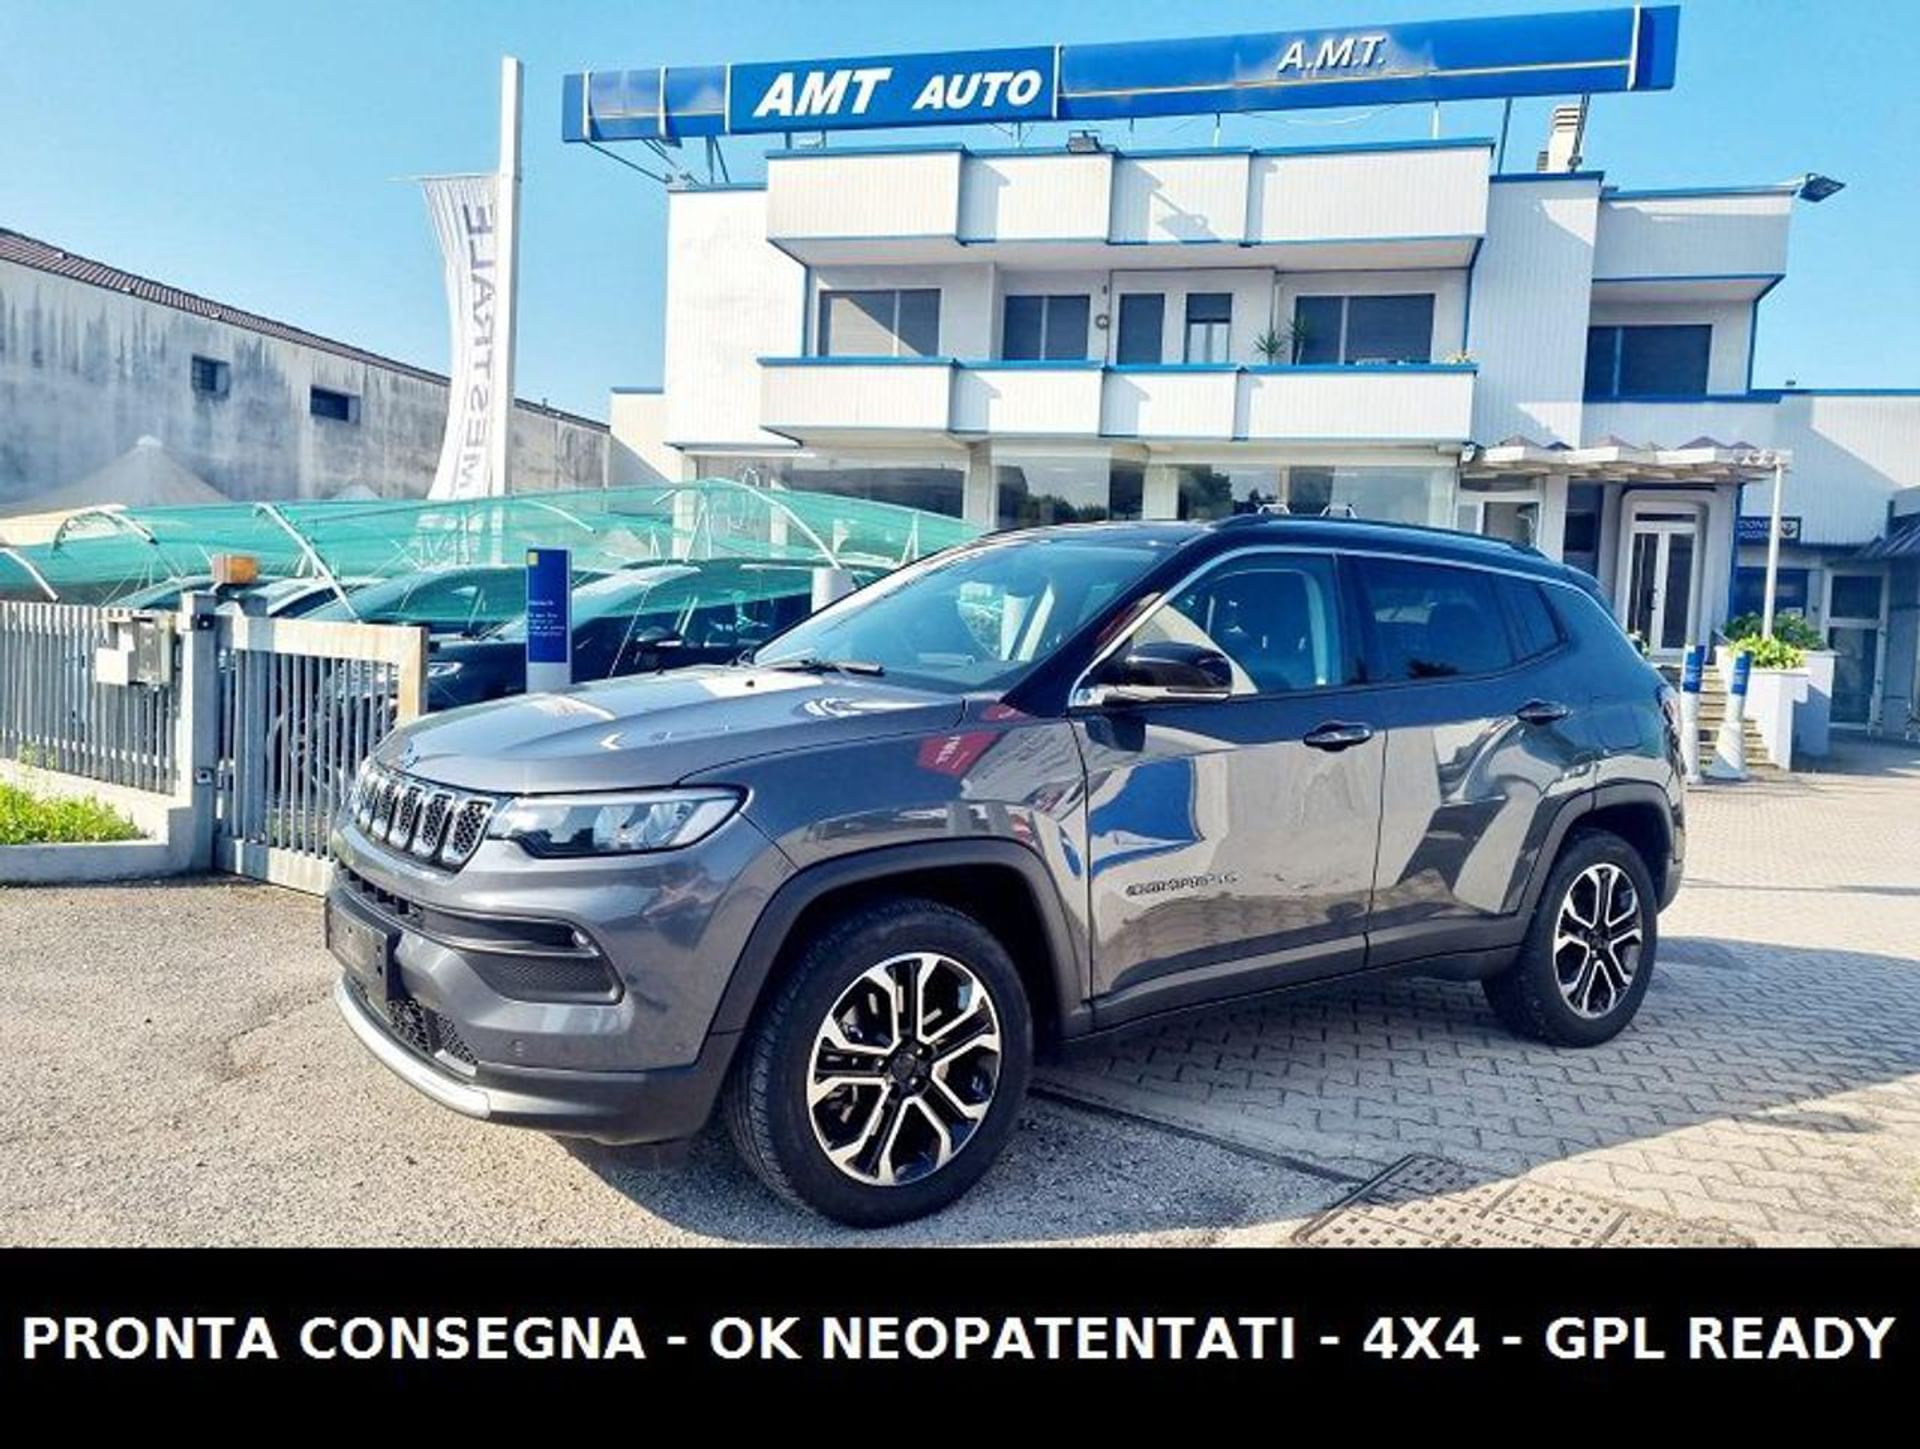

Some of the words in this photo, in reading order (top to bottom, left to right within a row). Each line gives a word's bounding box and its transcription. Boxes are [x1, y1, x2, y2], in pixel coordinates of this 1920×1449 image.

[1278, 35, 1386, 72] A.M.T.
[753, 68, 892, 118] AMT
[912, 69, 1042, 111] AUTO
